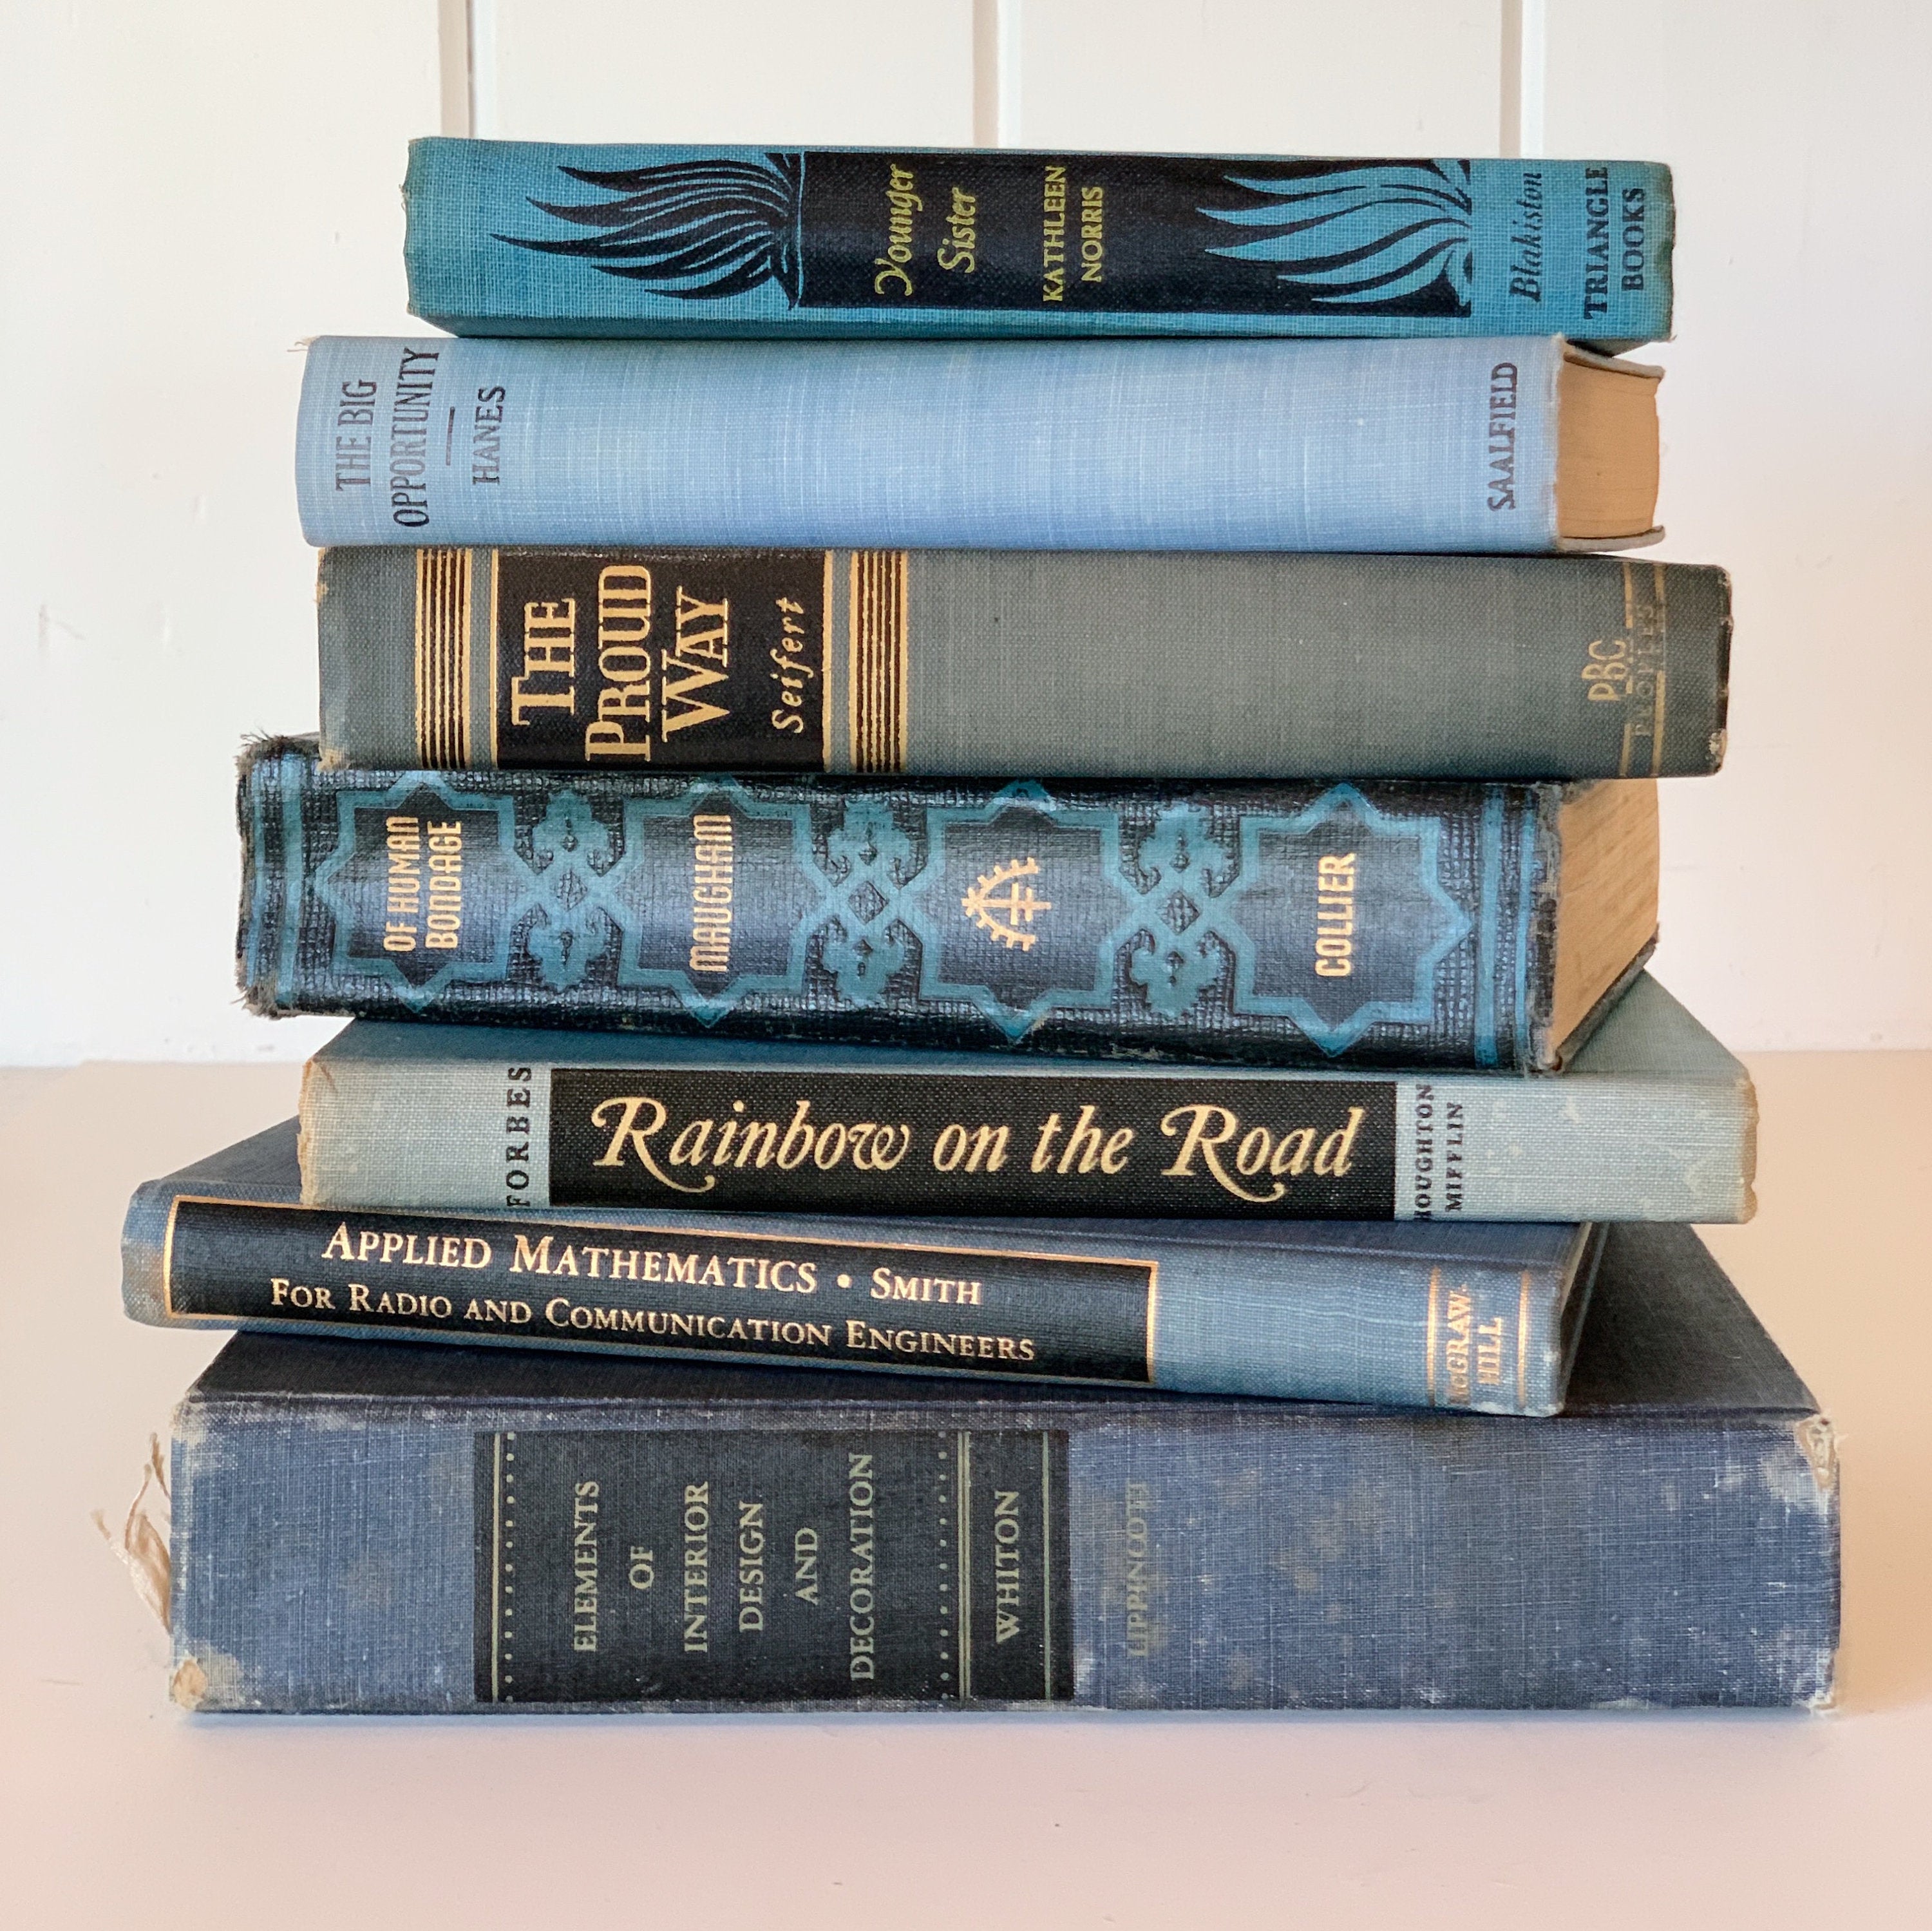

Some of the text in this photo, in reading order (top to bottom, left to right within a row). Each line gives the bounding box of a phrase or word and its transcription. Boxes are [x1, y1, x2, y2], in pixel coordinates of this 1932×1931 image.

[875, 164, 923, 296] Younger
[937, 187, 976, 273] Sister
[1043, 165, 1068, 302] KATHLEEN
[1081, 186, 1104, 282] NORRIS
[1510, 172, 1542, 303] Blakiston
[1583, 166, 1609, 320] TRIANGLE
[1621, 187, 1645, 291] BOOKS
[335, 379, 378, 491] THE BIG
[389, 347, 440, 528] OPPORTUNITY
[471, 385, 506, 486] HANES
[1486, 361, 1518, 512] SAALFIELD
[511, 597, 576, 726] THE
[585, 564, 652, 762] PROUD
[661, 585, 730, 743] WAY
[770, 596, 815, 734] Seifert
[1580, 639, 1628, 702] PBC
[382, 815, 421, 953] OF HUMAN
[424, 820, 462, 949] BONDAGE
[689, 814, 734, 973] MAUGHAM
[1314, 852, 1356, 977] COLLIER
[506, 1066, 533, 1208] FORBES
[591, 1096, 1363, 1204] Rainbow on the Road
[1444, 1101, 1464, 1212] MIFFLIN
[270, 1277, 1036, 1362] FOR RADIO AND COMMUNICATION ENGINEERS
[321, 1221, 983, 1306] APPLIED MATHEMATICS SMITH
[1477, 1317, 1502, 1385] HILL
[574, 1480, 600, 1653] ELEMENTS
[628, 1545, 654, 1590] OF
[684, 1481, 709, 1653] INTERIOR
[738, 1500, 764, 1633] DESIGN
[794, 1527, 819, 1606] AND
[848, 1452, 875, 1682] DECORATION
[994, 1490, 1020, 1645] WHITON
